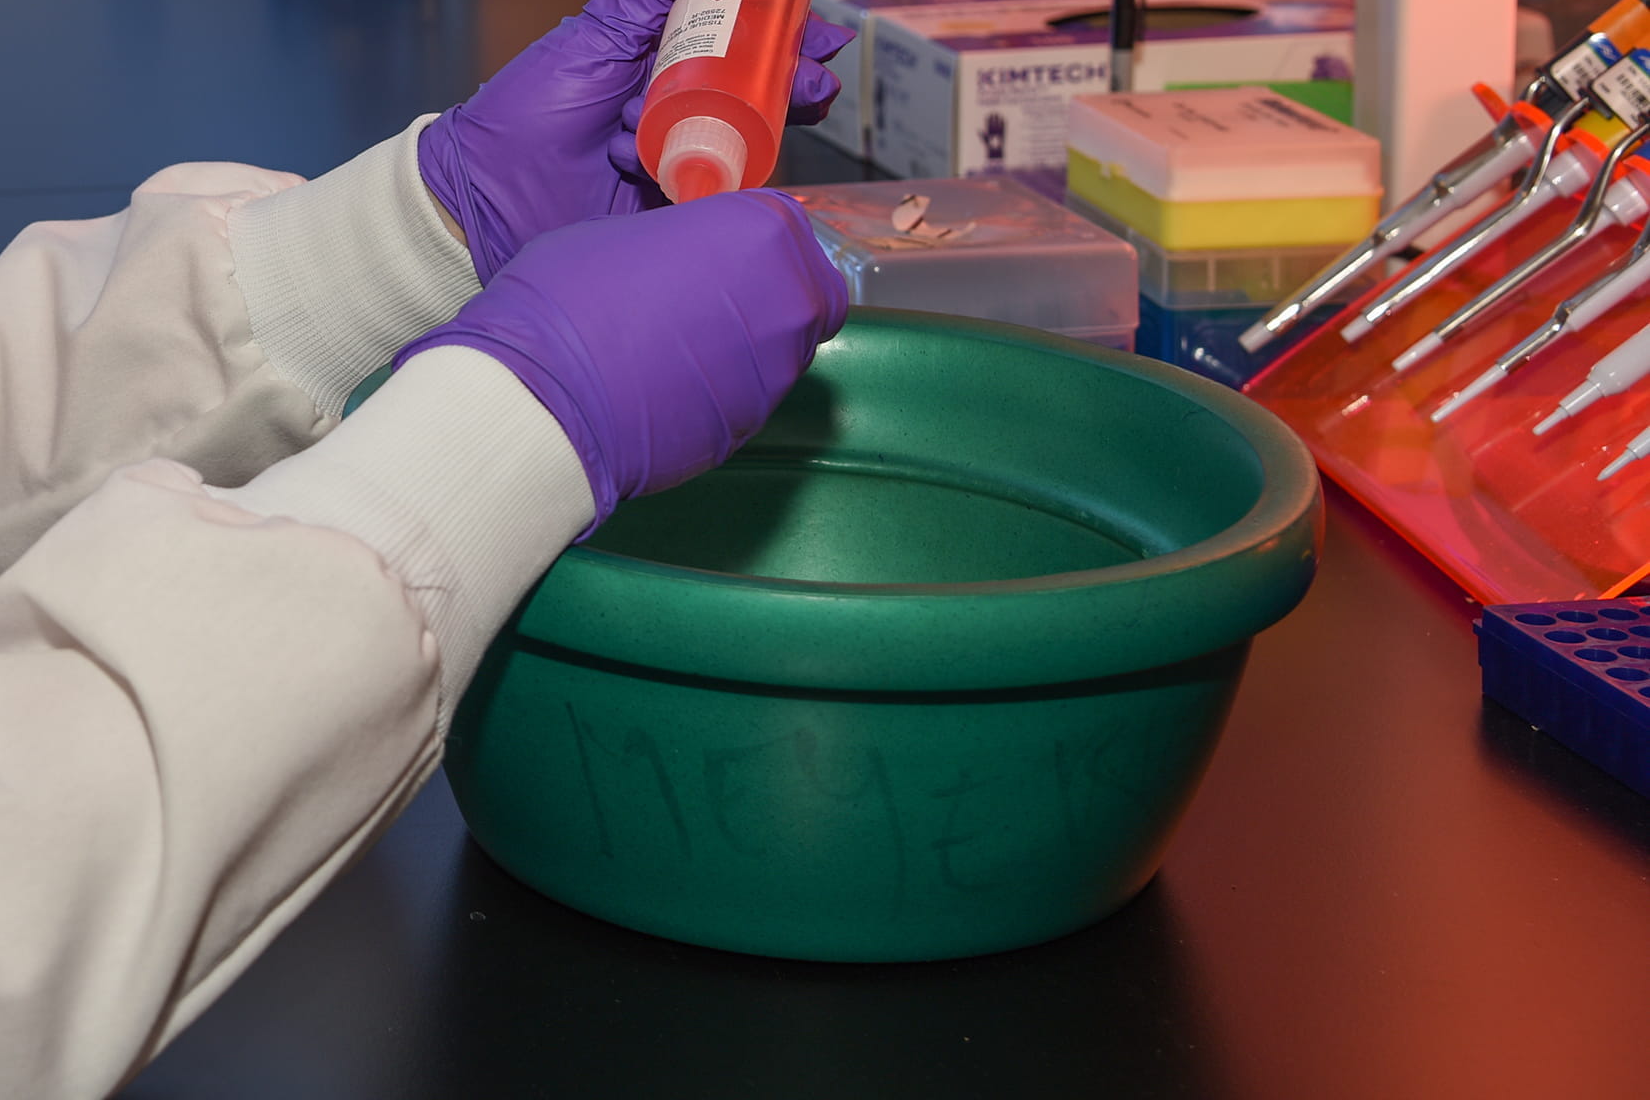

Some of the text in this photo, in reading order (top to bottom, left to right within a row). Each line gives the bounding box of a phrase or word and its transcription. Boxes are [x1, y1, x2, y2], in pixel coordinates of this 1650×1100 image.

[687, 14, 725, 26] MEDIUM
[688, 20, 722, 30] TISSUE
[977, 62, 1107, 85] KIMTECH
